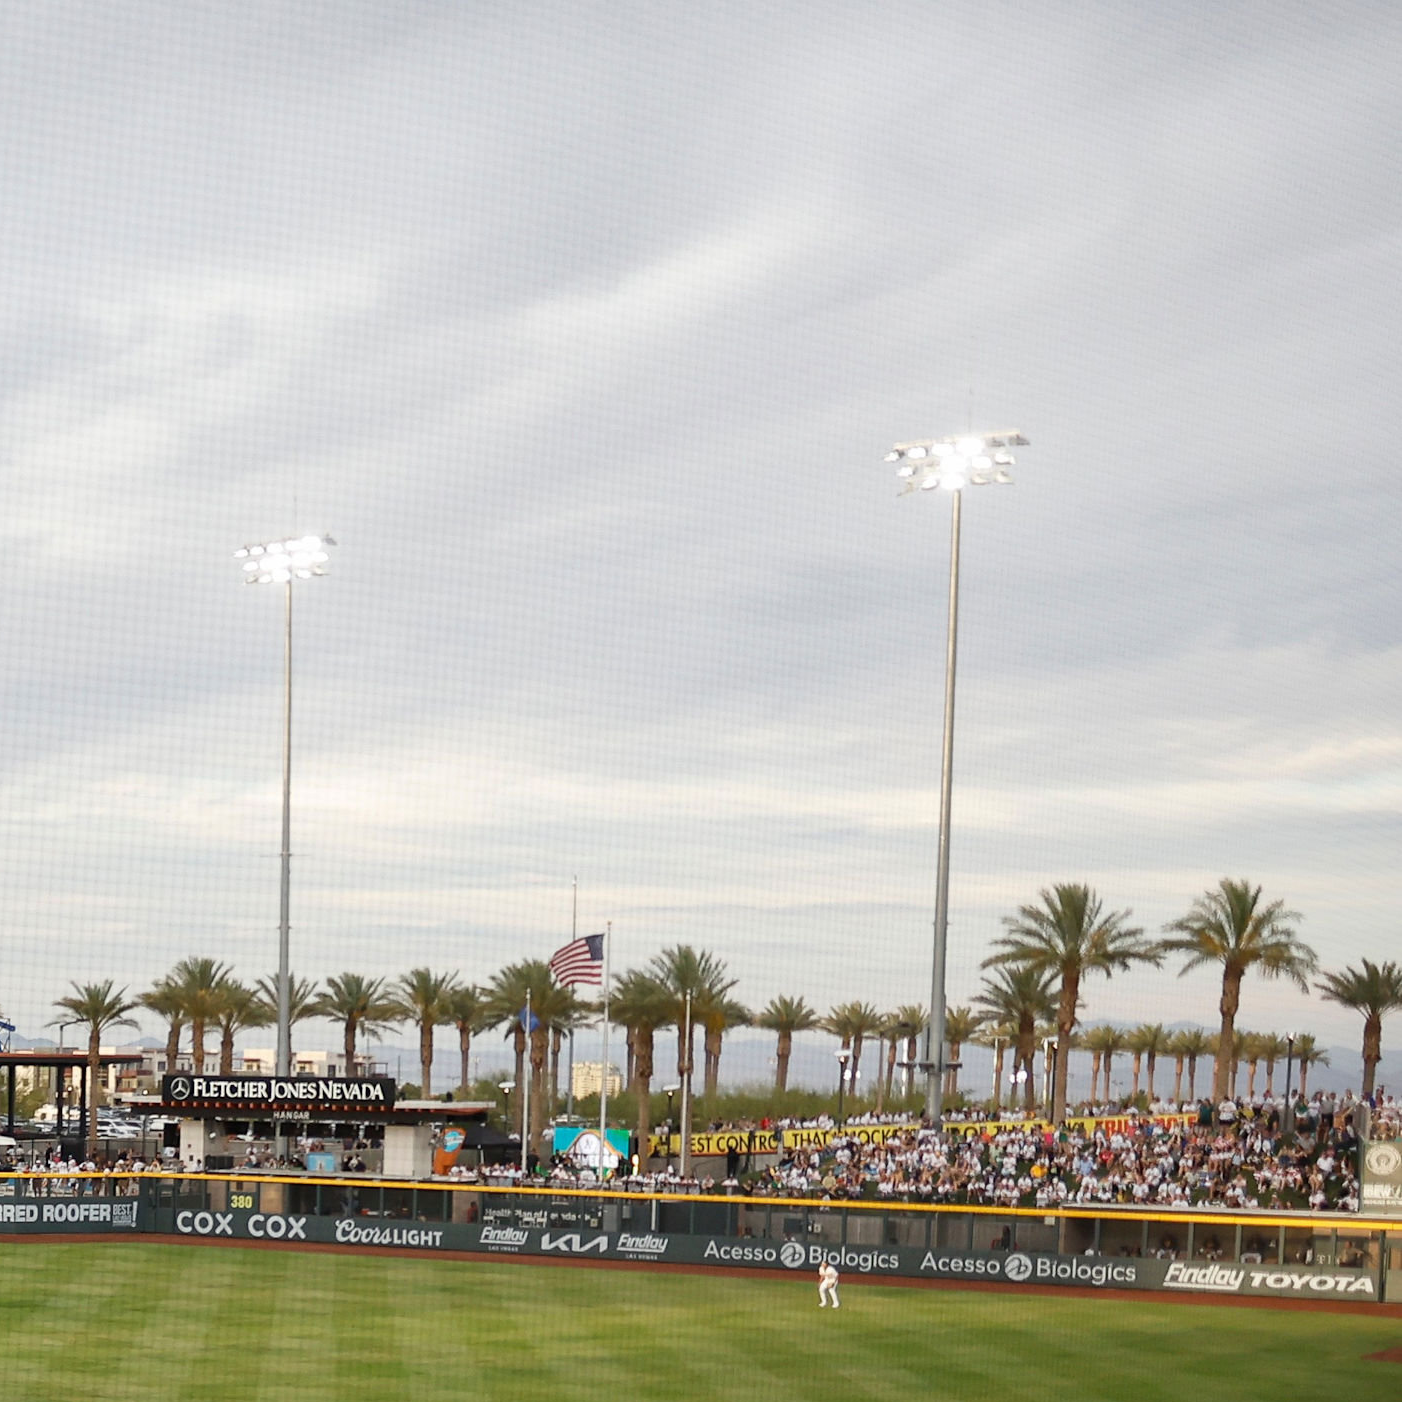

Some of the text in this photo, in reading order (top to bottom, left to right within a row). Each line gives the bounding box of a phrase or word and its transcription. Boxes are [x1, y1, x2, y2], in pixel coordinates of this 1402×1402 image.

[193, 1078, 384, 1102] FLETCHER JONES NEVADA
[273, 1111, 310, 1120] HANGAR
[112, 1203, 132, 1215] BEST
[230, 1194, 253, 1209] 380
[42, 1203, 111, 1223] ROOFER
[177, 1211, 307, 1240] COX COX
[335, 1218, 443, 1247] Coors LIGHT
[480, 1226, 529, 1244] Findlay
[617, 1233, 669, 1250] Findlay
[704, 1240, 900, 1272] Acesso Biologics
[920, 1250, 1136, 1285] Acesso Biologics
[1163, 1261, 1374, 1294] Findlay TOYOTA
